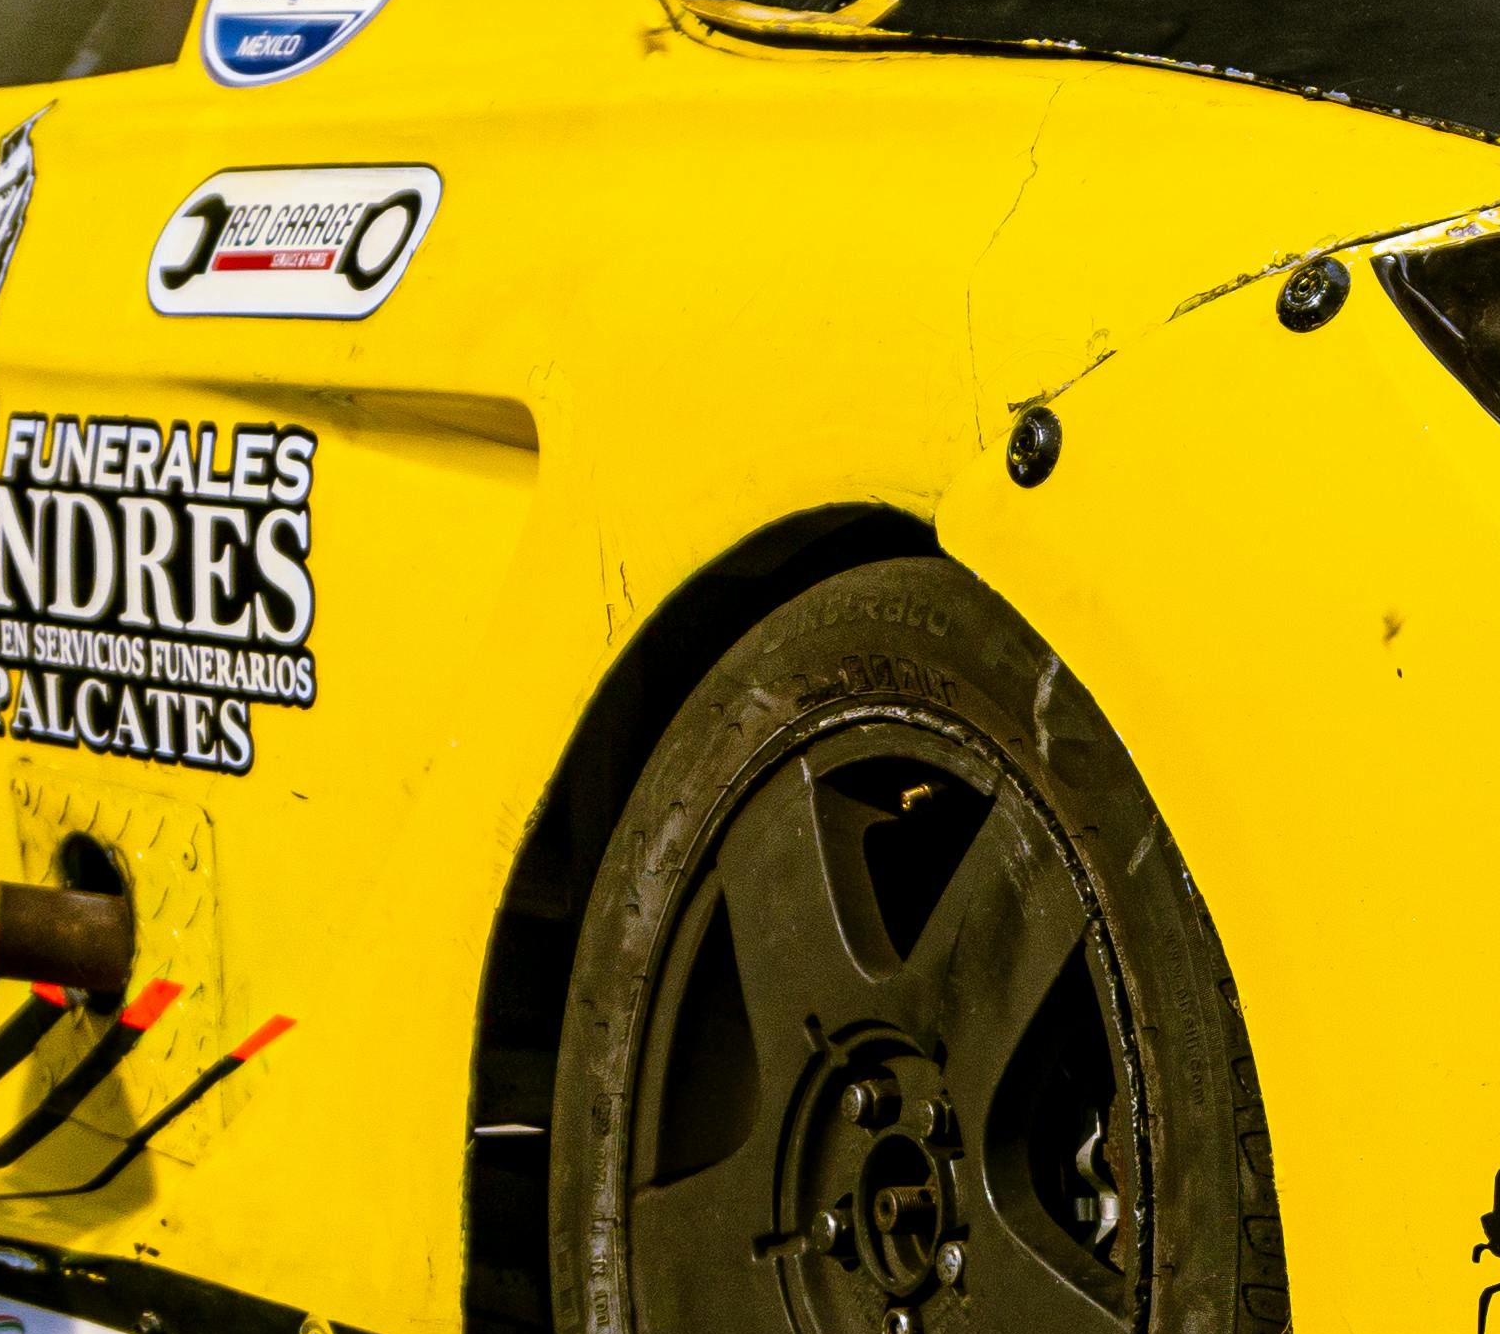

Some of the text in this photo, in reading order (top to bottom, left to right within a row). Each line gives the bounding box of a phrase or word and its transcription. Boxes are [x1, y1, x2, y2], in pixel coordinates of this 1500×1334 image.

[235, 30, 302, 58] MÉXICO
[220, 201, 364, 248] RED GARAGE
[2, 417, 313, 503] FUNERALES
[1, 622, 30, 661] EN
[33, 625, 147, 678] SERVICIOS
[150, 639, 314, 701] FUNERARIOS
